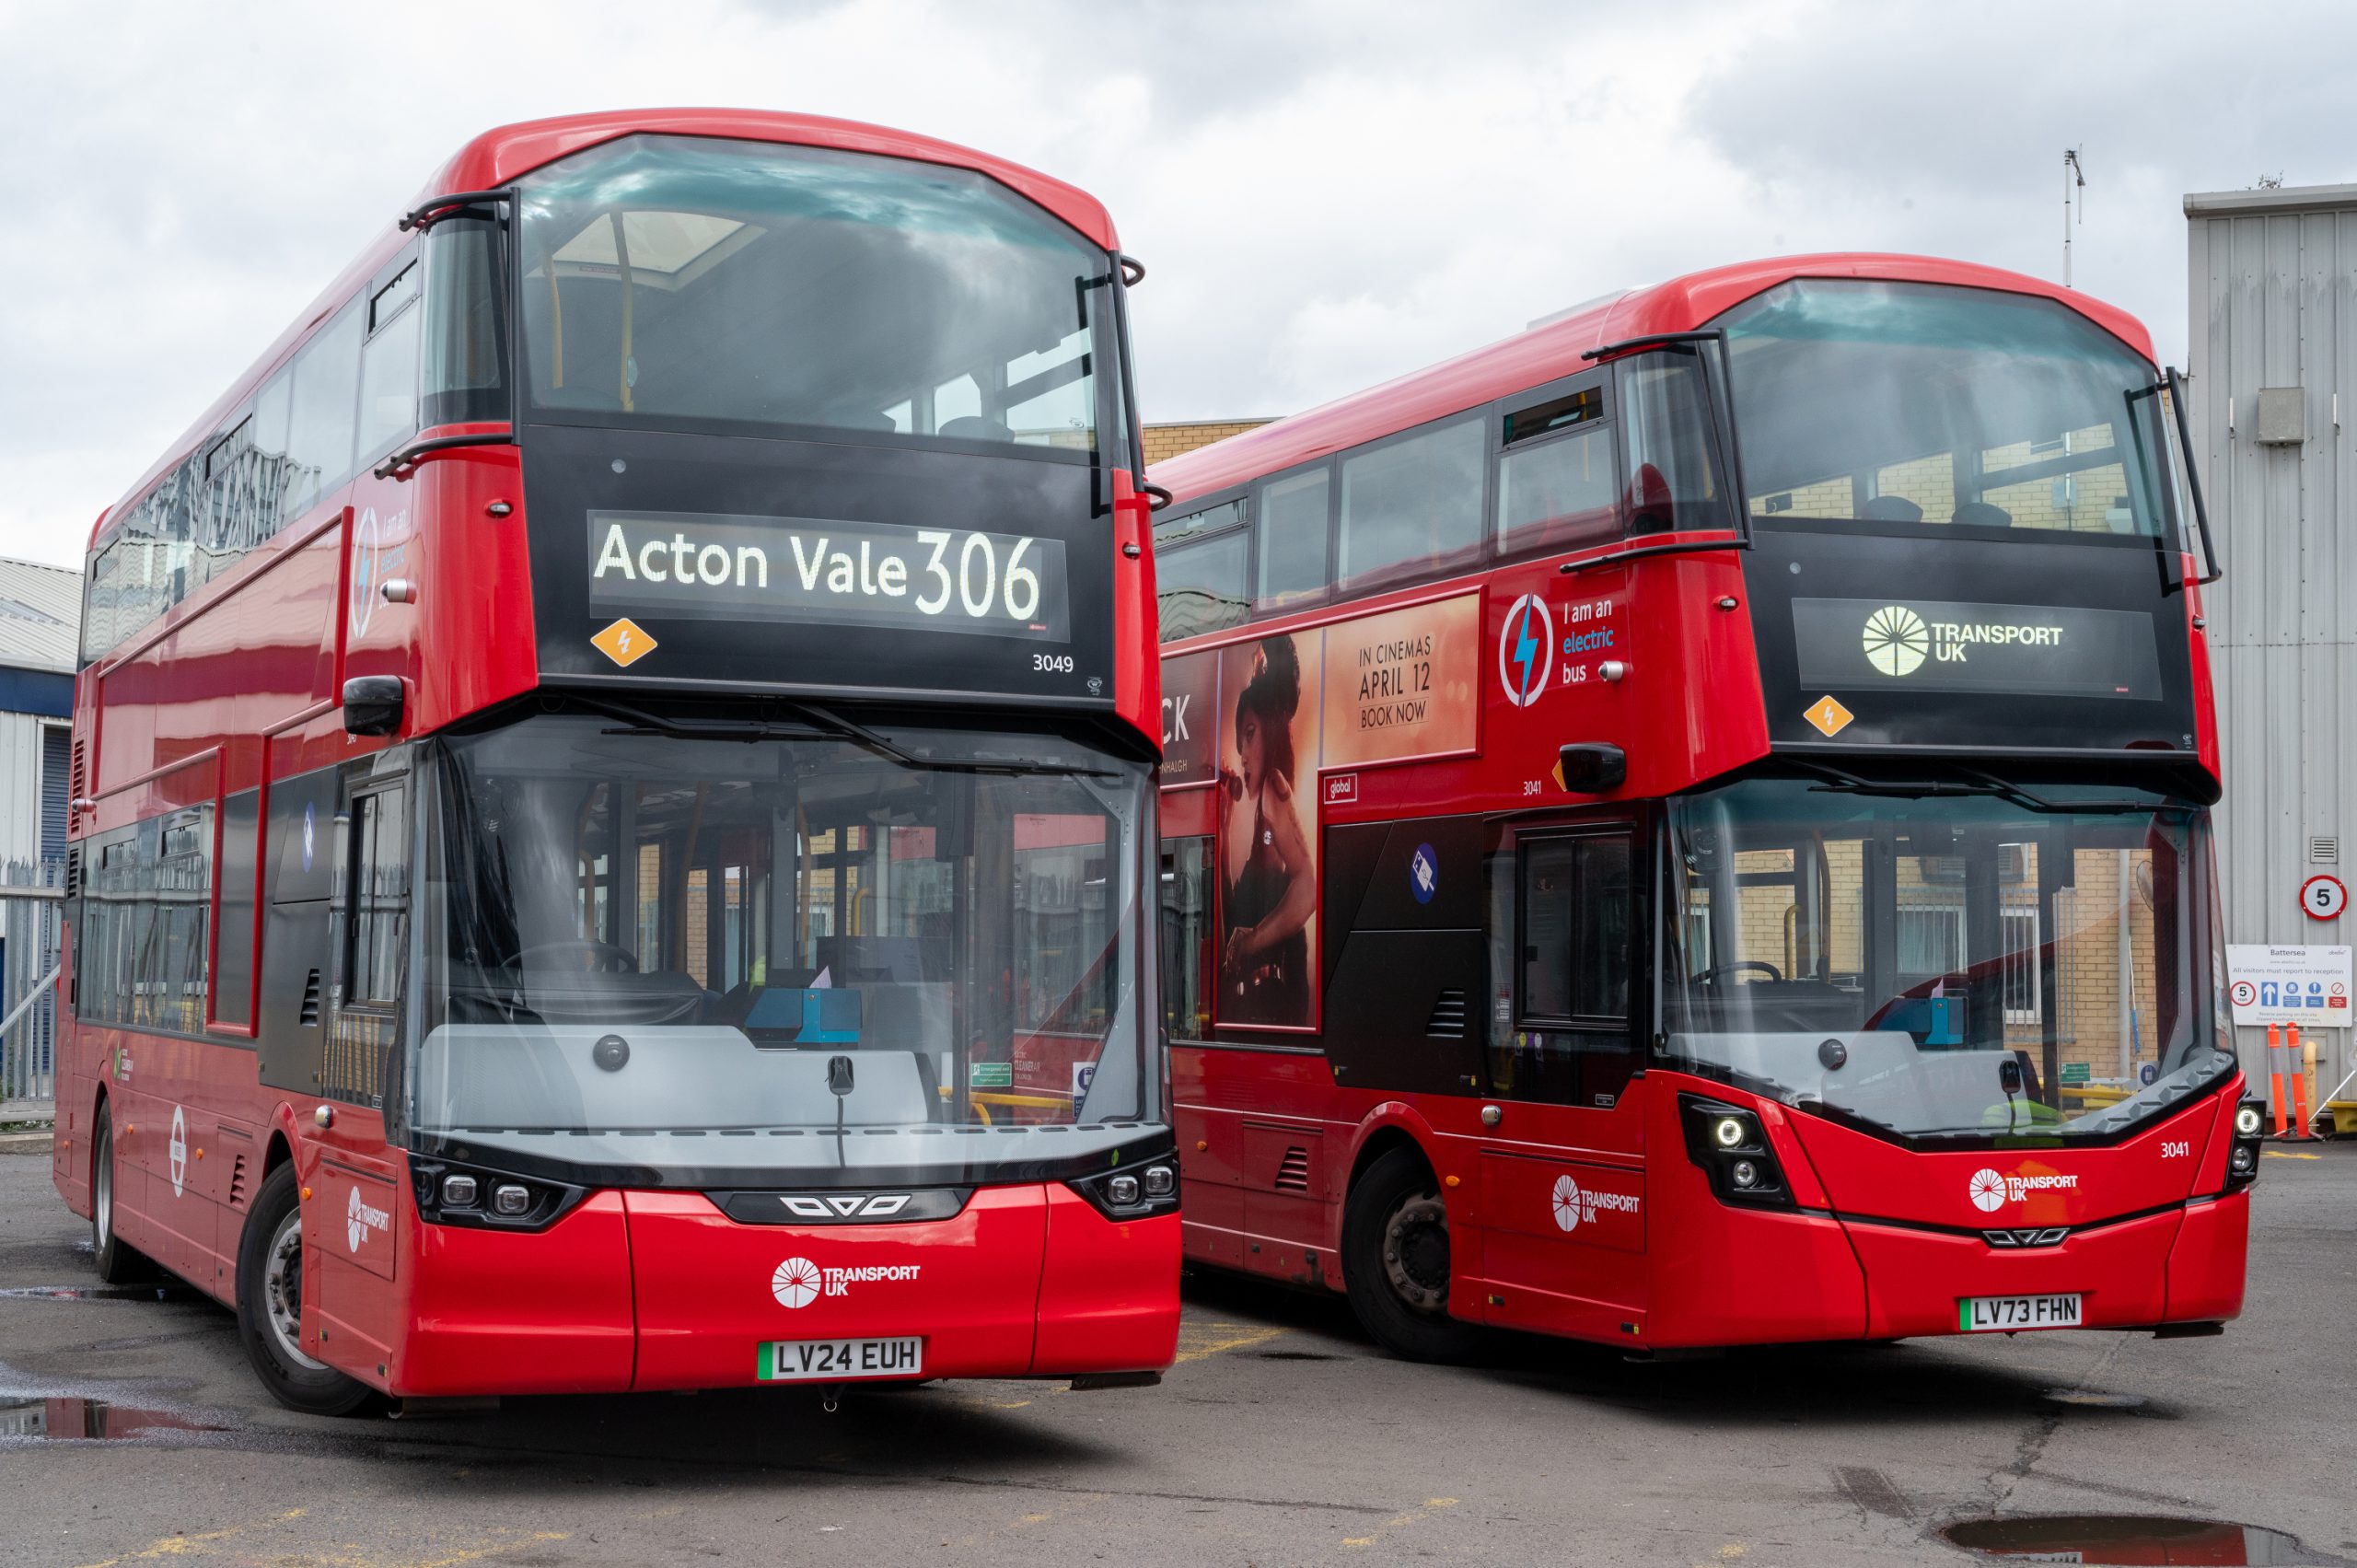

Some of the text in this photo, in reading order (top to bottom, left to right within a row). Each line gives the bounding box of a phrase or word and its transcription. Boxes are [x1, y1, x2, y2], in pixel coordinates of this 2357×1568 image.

[387, 516, 397, 538] am
[398, 508, 406, 530] an
[593, 524, 1039, 621] Acton Vale 306
[1564, 599, 1612, 624] I am an
[1562, 625, 1614, 654] electric
[1931, 623, 2063, 645] TRANSPORT
[1359, 635, 1431, 668] IN CINEMAS
[1935, 642, 1967, 662] UK
[1033, 654, 1074, 673] 3049
[1562, 662, 1586, 684] bus
[1359, 661, 1430, 702] APRIL 12
[1361, 700, 1426, 728] BOOK NOW
[1159, 759, 1188, 774] NHALGH
[1330, 778, 1351, 800] global
[1523, 781, 1541, 796] 3041
[2316, 889, 2330, 907] 5
[2239, 986, 2247, 997] 5
[2161, 1142, 2189, 1158] 3041
[2006, 1175, 2078, 1191] TRANSPORT
[1580, 1190, 1640, 1214] TRANSPORT
[2008, 1190, 2026, 1202] UK
[361, 1203, 389, 1232] TRANSPORT
[1582, 1206, 1596, 1223] UK
[361, 1224, 368, 1244] UK
[822, 1265, 921, 1282] TRANSPORT
[825, 1282, 849, 1296] UK
[1975, 1296, 2076, 1325] LV73 FHN
[778, 1341, 915, 1374] LV24 EUH
